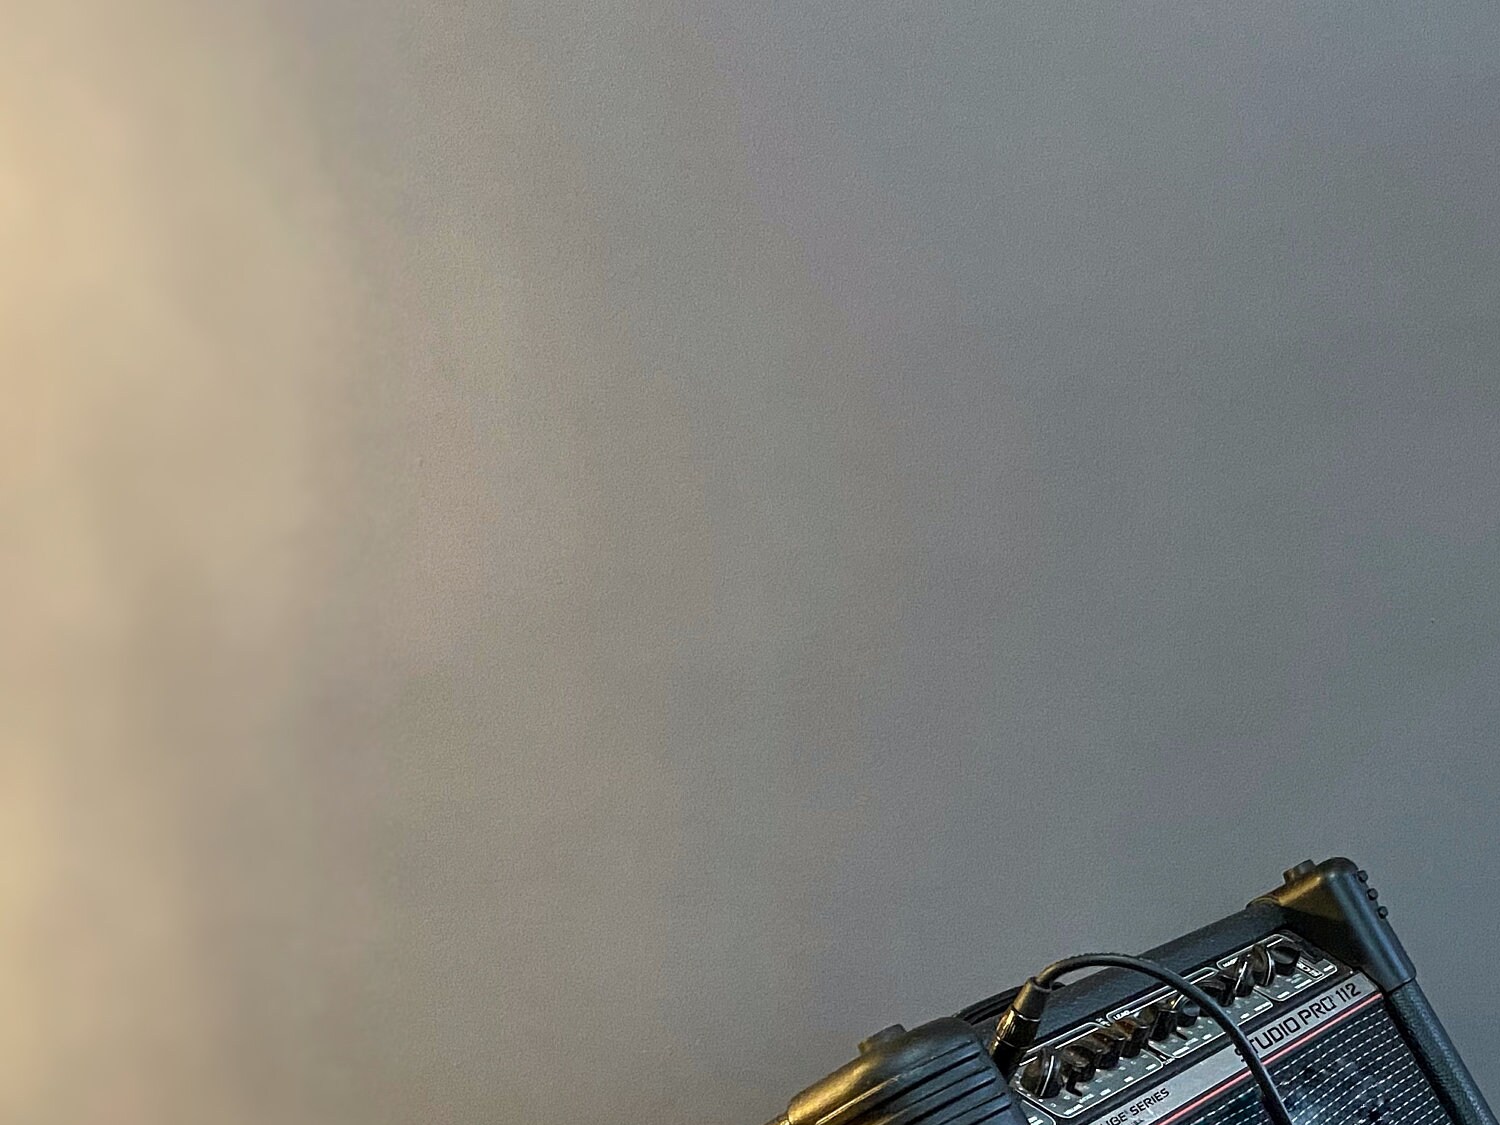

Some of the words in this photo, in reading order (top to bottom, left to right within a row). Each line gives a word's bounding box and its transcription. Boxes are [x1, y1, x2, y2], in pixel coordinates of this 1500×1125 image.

[1297, 996, 1337, 1026] PRO
[1335, 982, 1361, 1003] 112
[1129, 1087, 1170, 1116] SERIES
